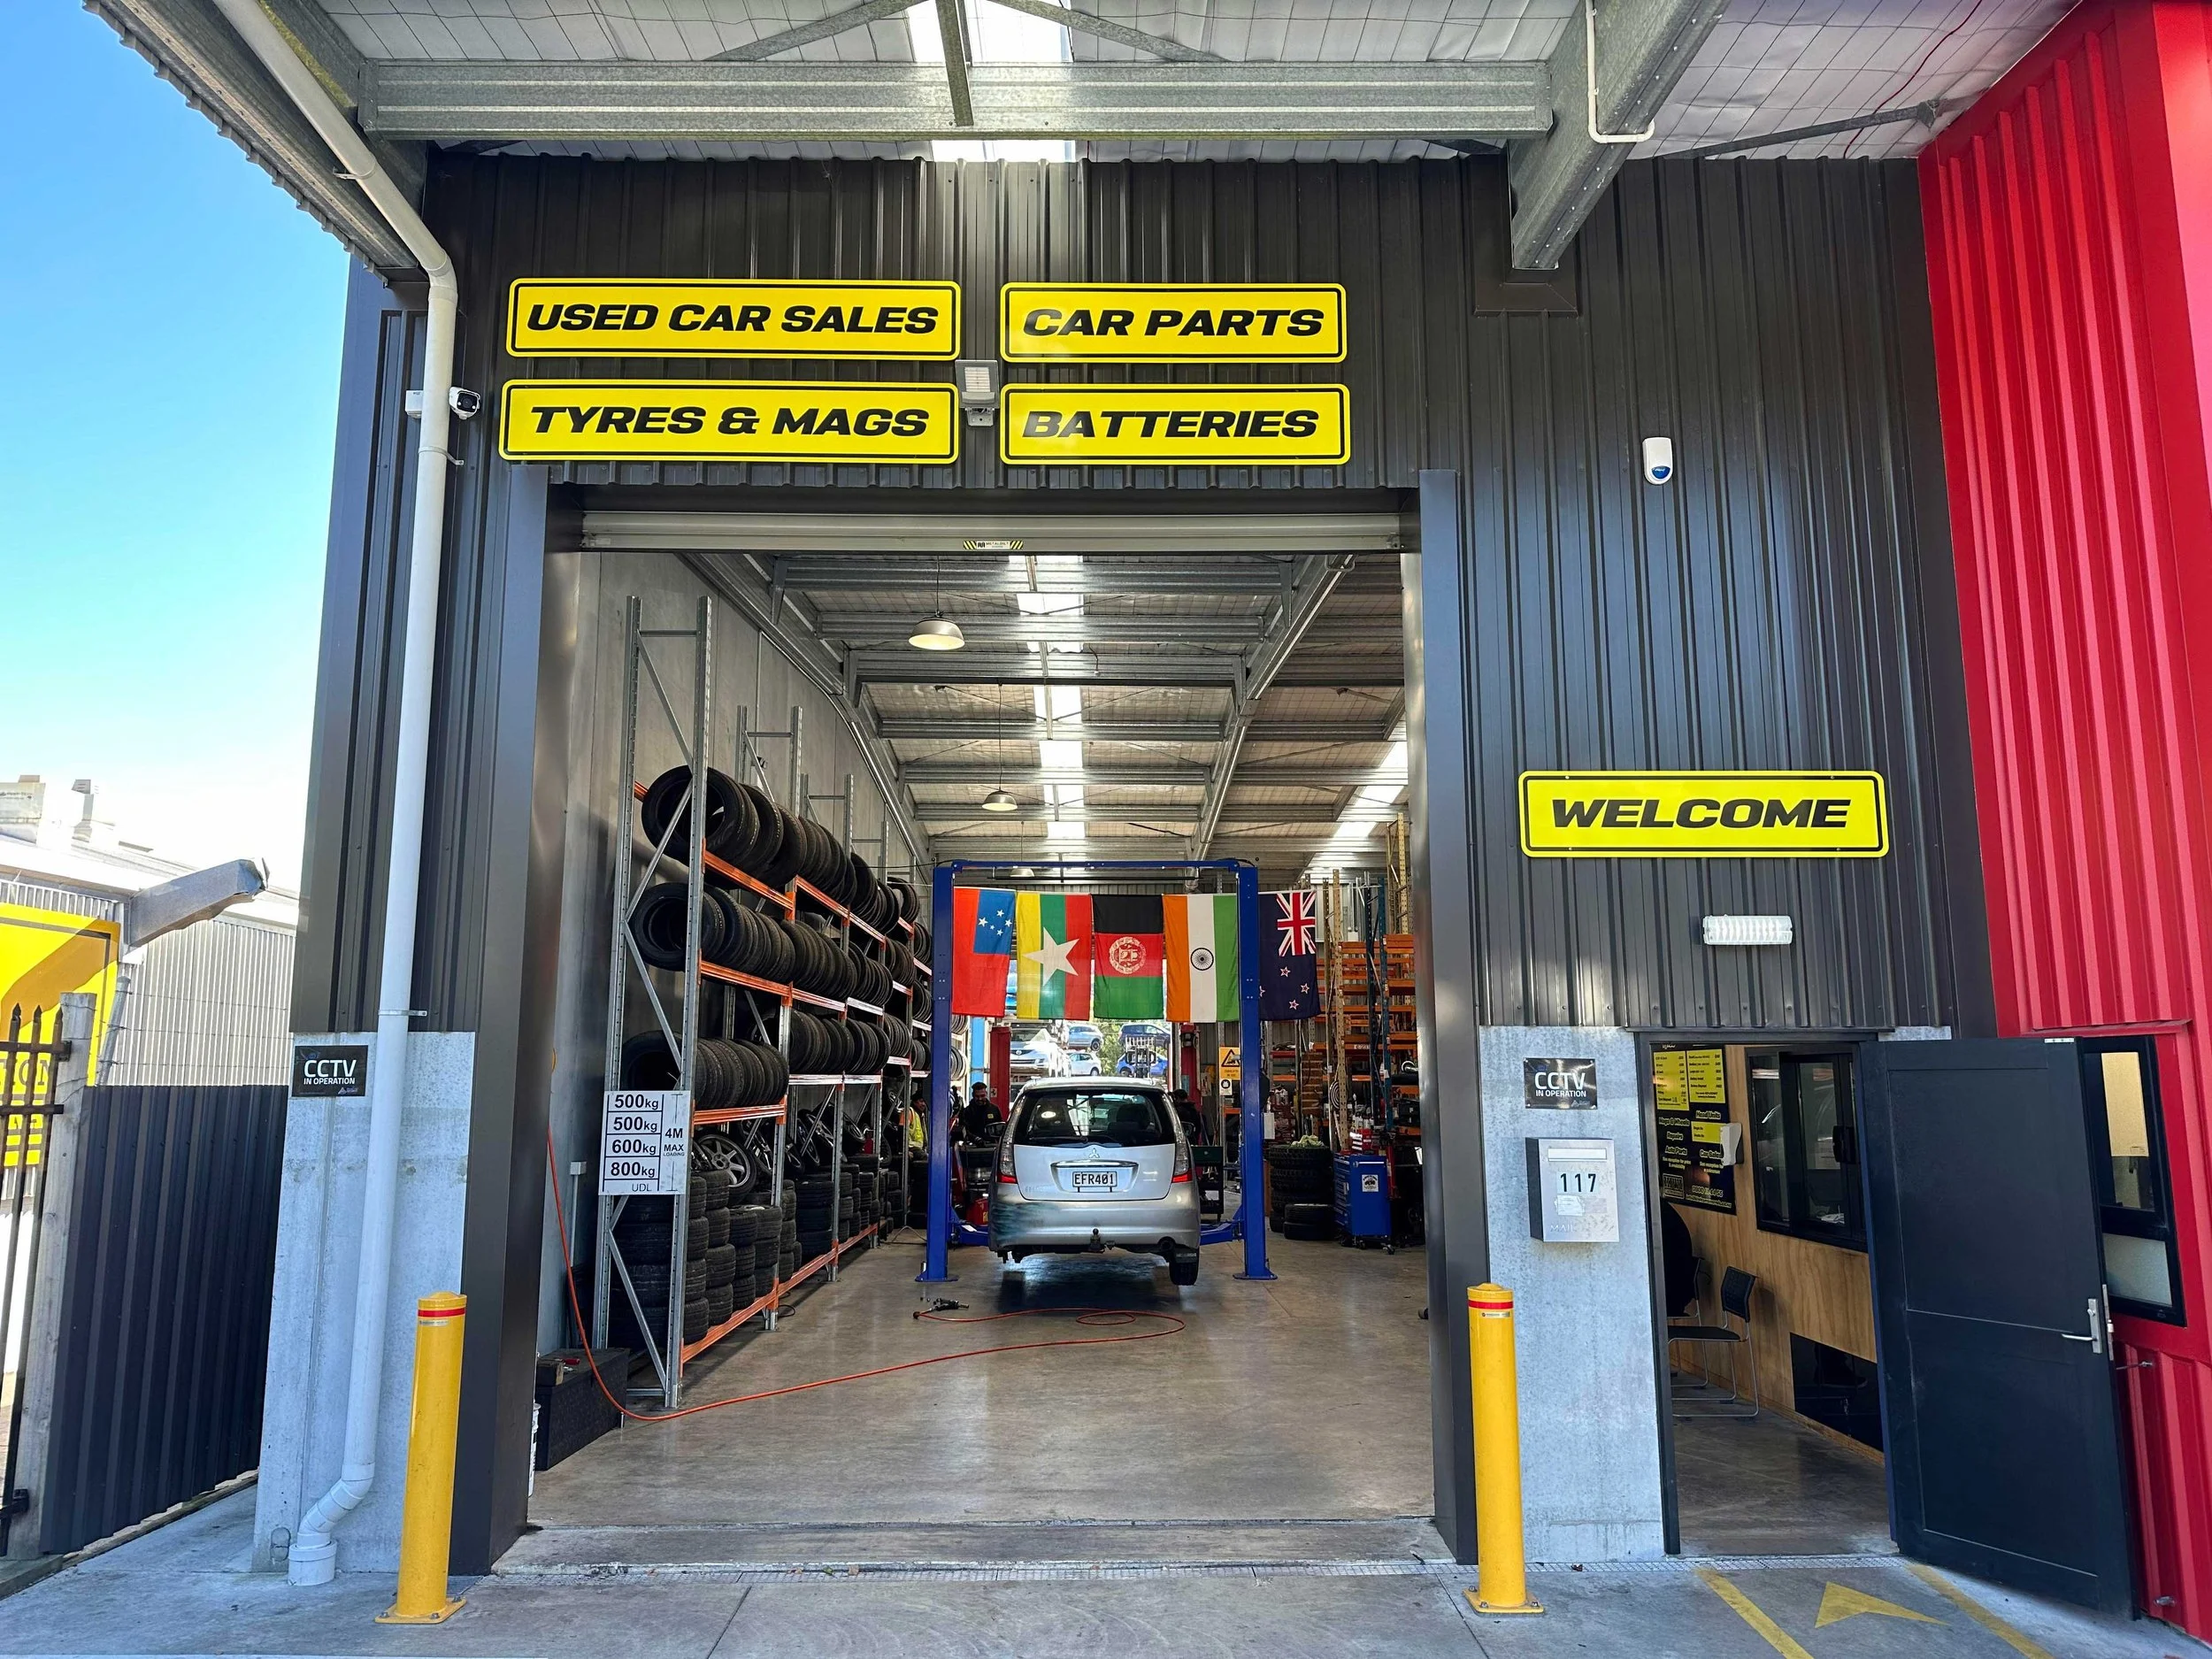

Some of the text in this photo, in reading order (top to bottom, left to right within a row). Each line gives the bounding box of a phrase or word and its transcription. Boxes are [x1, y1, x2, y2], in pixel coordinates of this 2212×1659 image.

[527, 303, 939, 334] USED CAR SALES
[1022, 308, 1325, 337] CAR PARTS
[531, 406, 930, 436] TYRES & MAGS
[1022, 410, 1320, 438] BATTERIES
[1552, 798, 1851, 828] WELCOME
[303, 1059, 357, 1078] CCTV
[1534, 1071, 1586, 1090] CCTV
[614, 1094, 659, 1110] 500kg
[613, 1117, 657, 1133] 500kg
[664, 1128, 683, 1139] 4M
[611, 1139, 657, 1156] 600kg
[611, 1162, 656, 1178] 800kg
[1074, 1173, 1114, 1185] EFR401
[632, 1183, 652, 1192] UDL
[1560, 1173, 1597, 1193] 117
